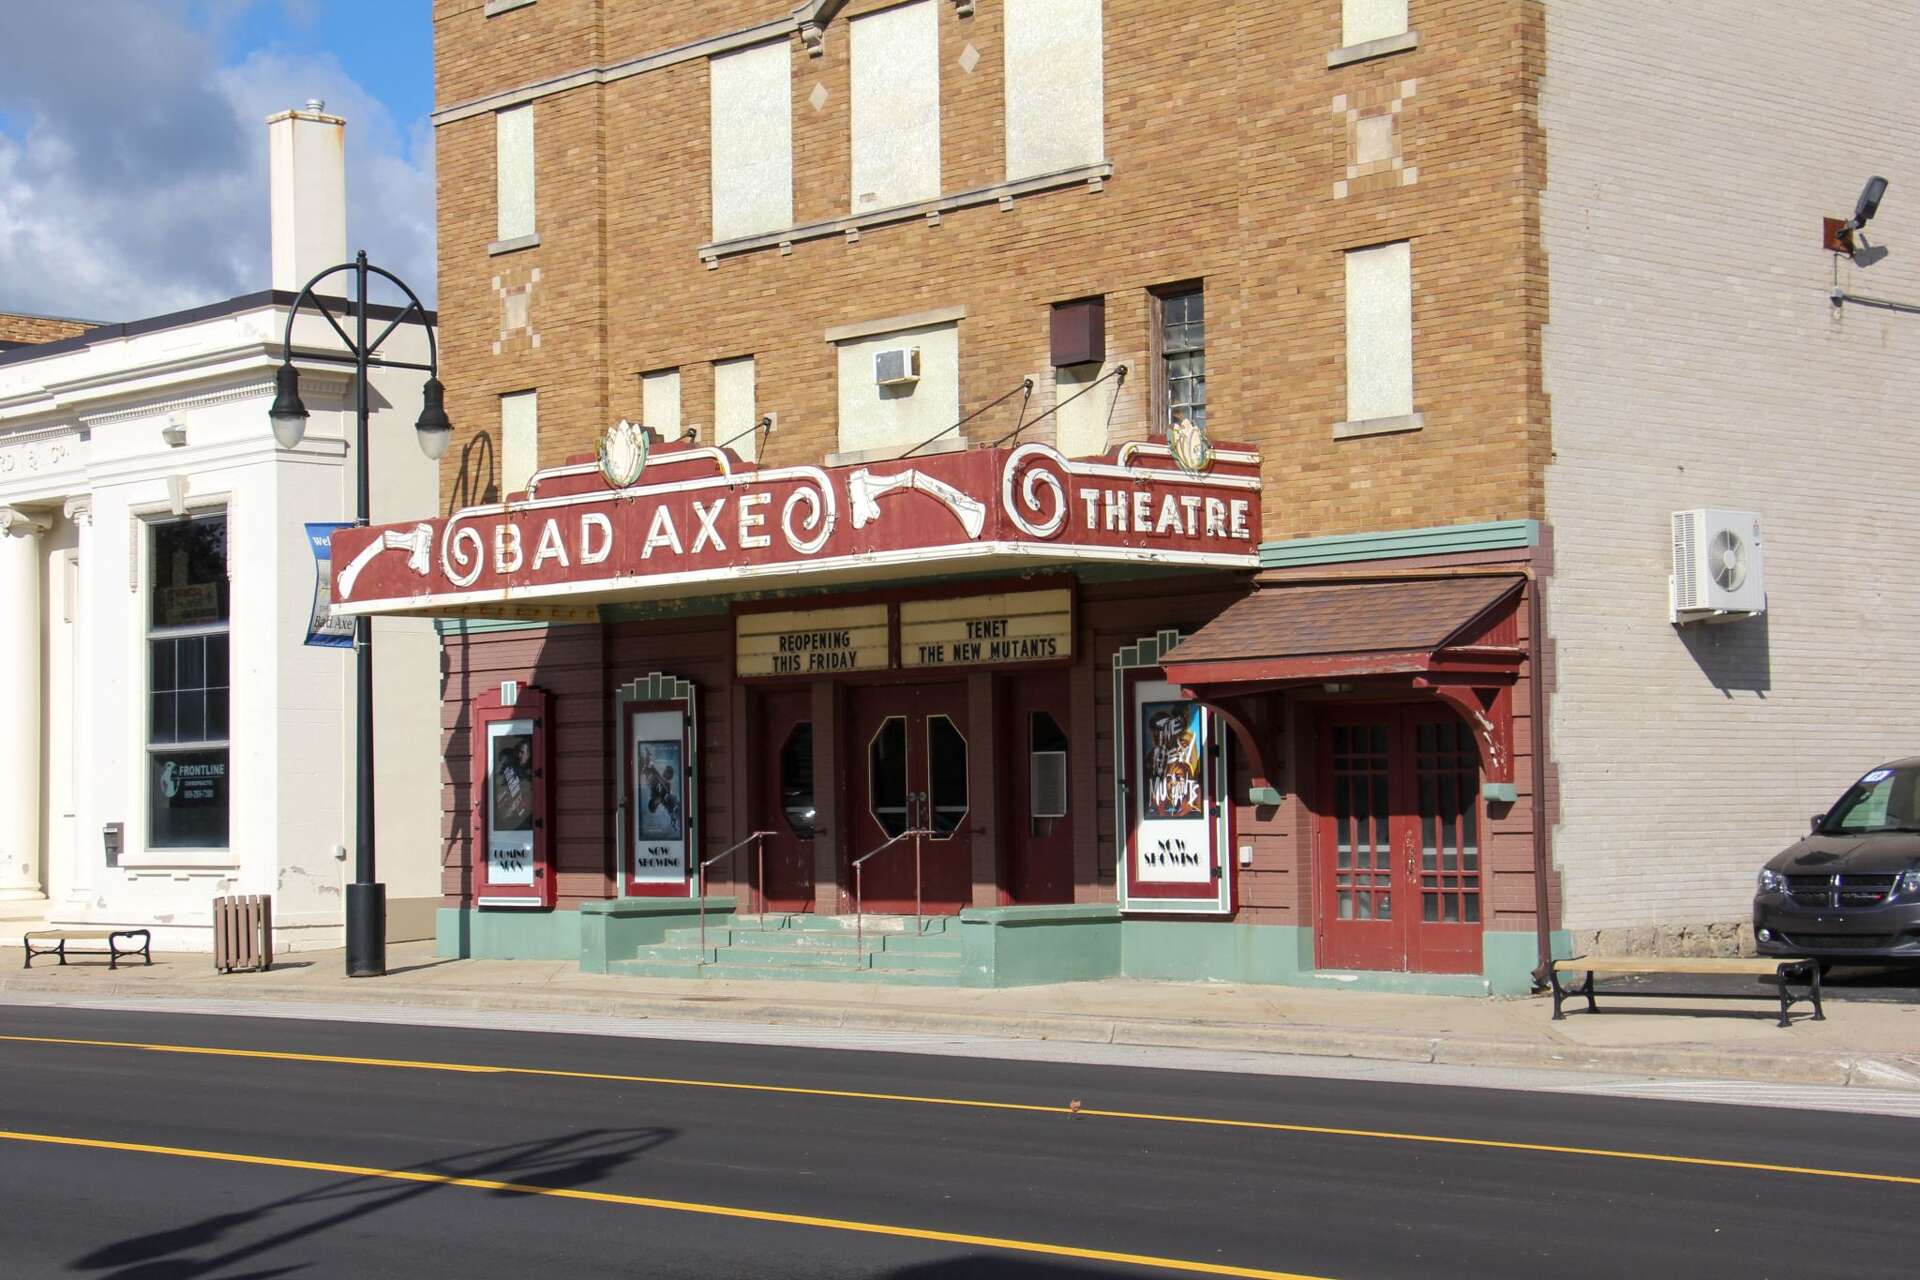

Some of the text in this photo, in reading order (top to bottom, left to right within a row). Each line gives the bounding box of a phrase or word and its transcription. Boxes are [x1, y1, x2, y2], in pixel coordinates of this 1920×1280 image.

[1080, 488, 1250, 539] THEATRE
[495, 492, 772, 575] BAD AXE
[335, 616, 353, 630] Axe
[966, 619, 1008, 639] TENET
[779, 631, 850, 653] REOPENING
[918, 638, 1057, 663] THE NEW MUTANTS
[772, 651, 857, 673] THIS FRIDAY
[179, 764, 225, 777] FRONTLINE
